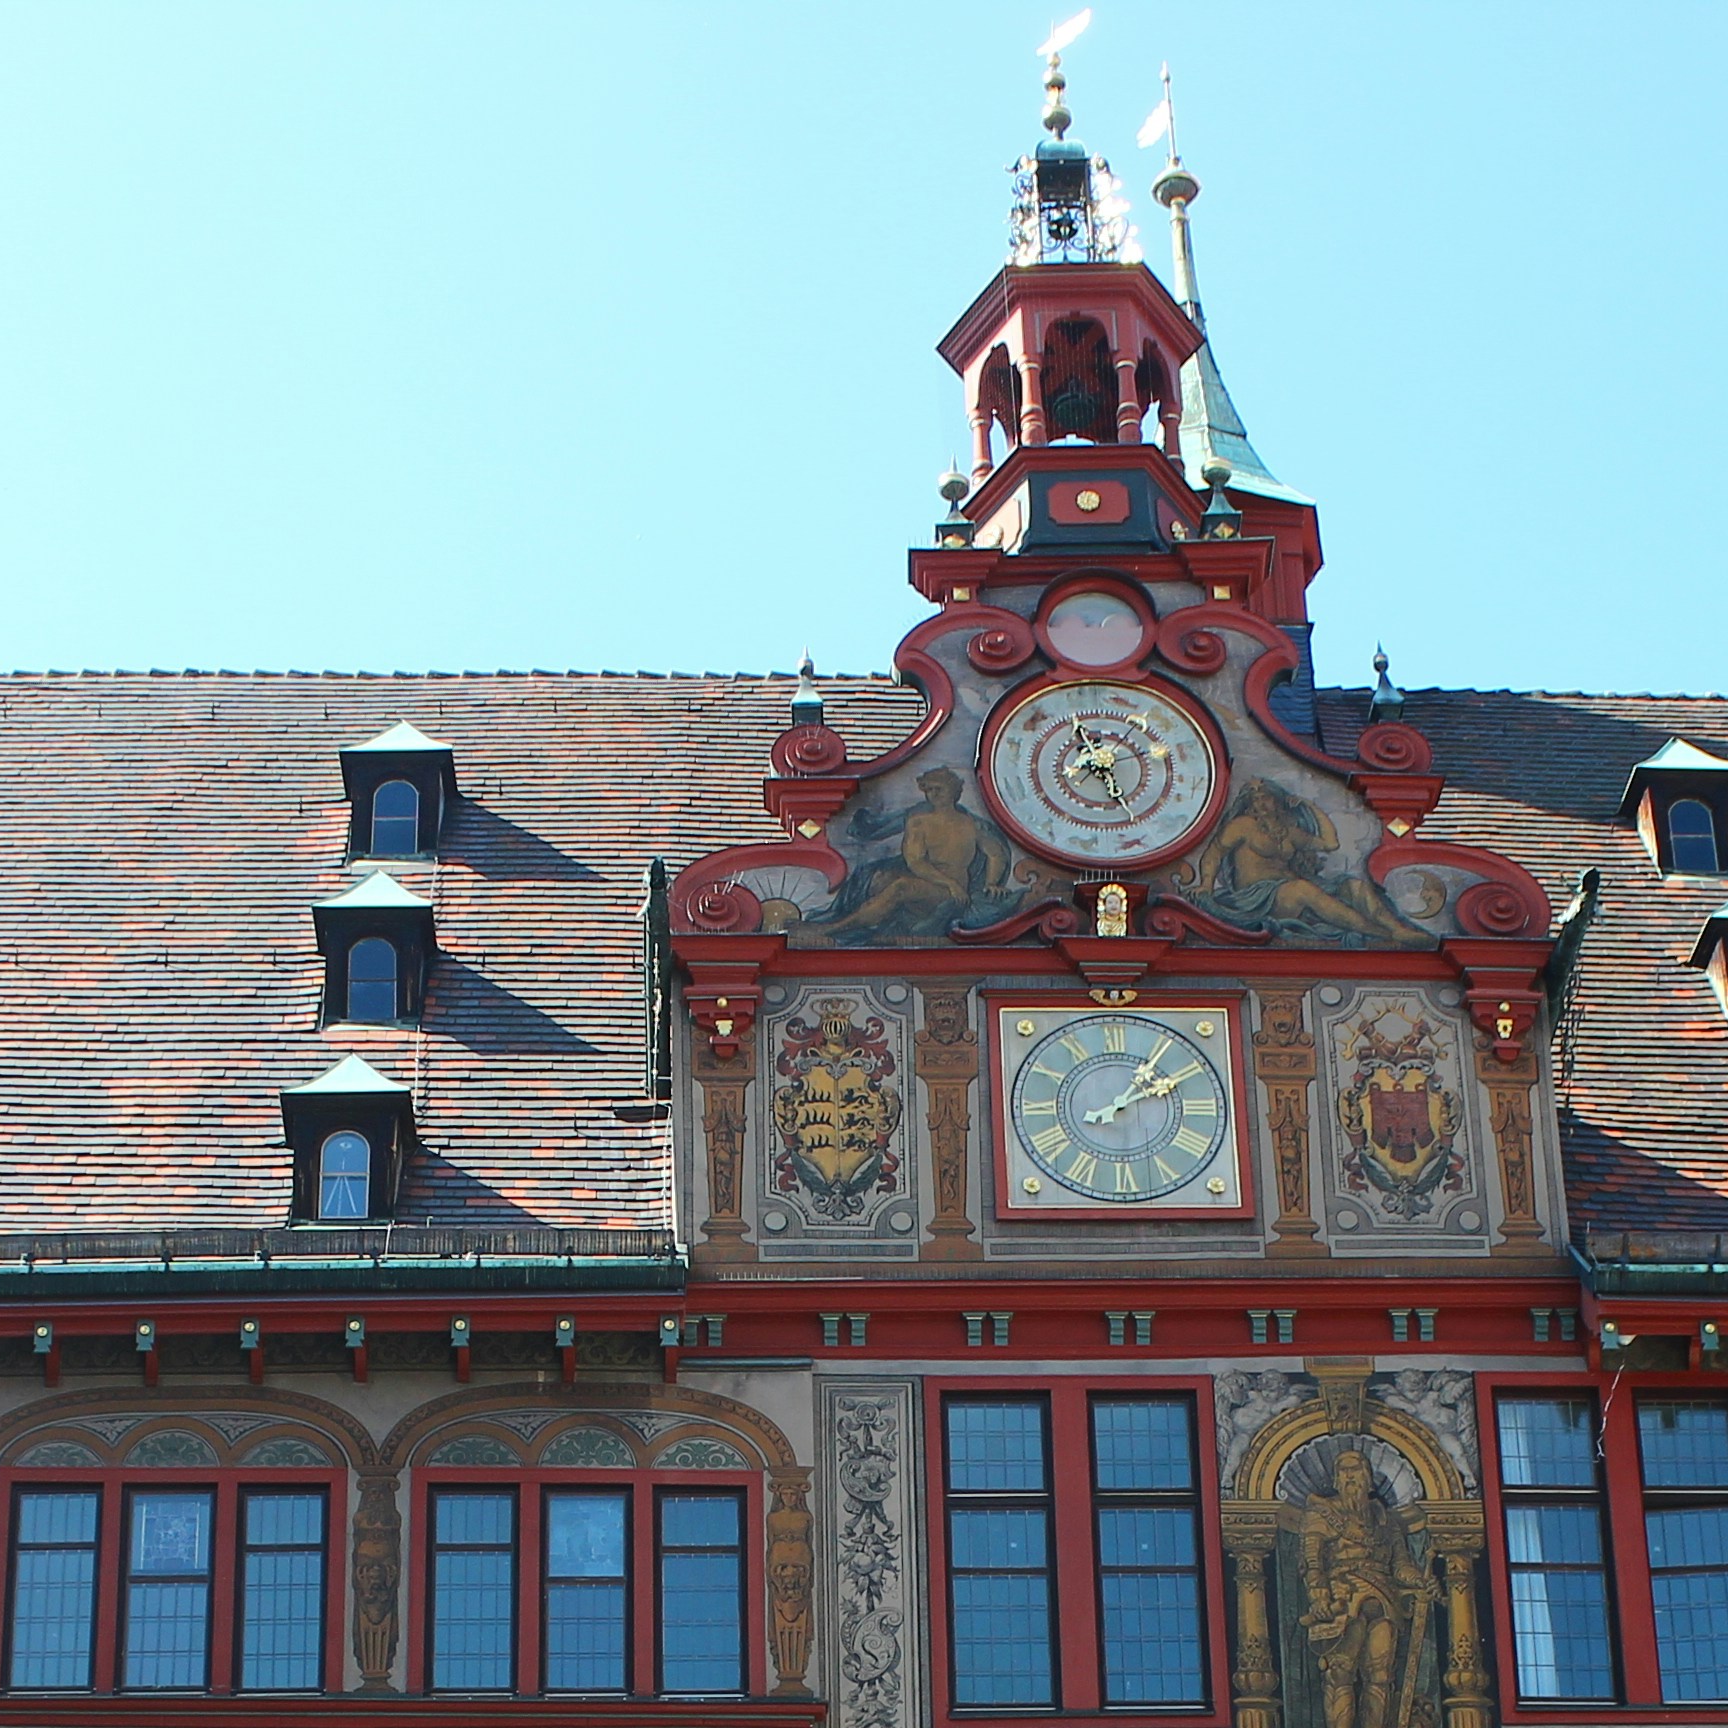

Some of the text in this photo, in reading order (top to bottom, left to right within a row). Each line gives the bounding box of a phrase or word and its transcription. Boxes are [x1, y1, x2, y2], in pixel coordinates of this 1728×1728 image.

[1059, 1034, 1089, 1064] XI
[1103, 1025, 1125, 1053] XII
[1031, 1062, 1066, 1084] X
[1023, 1099, 1057, 1116] IX
[1182, 1098, 1217, 1117] III
[1029, 1125, 1071, 1165] VIII
[1171, 1126, 1212, 1159] IIII
[1063, 1153, 1098, 1188] VII
[1114, 1162, 1140, 1193] VI
[1153, 1155, 1181, 1184] V
